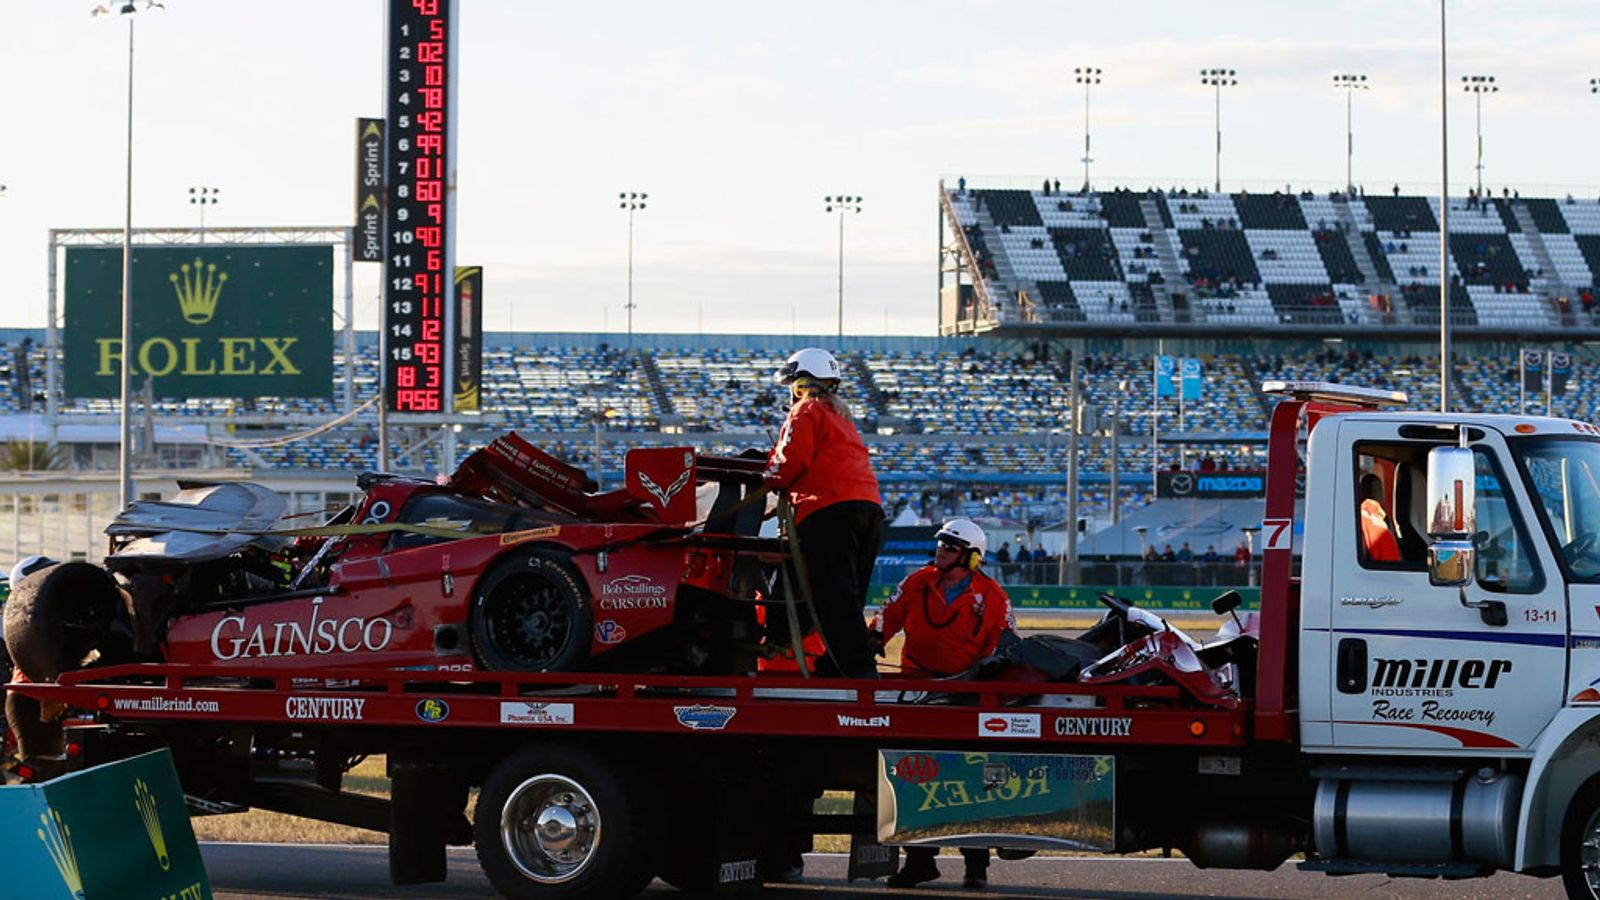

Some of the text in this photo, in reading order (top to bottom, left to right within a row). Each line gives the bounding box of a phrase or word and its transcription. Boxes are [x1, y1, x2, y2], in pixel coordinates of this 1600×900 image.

[400, 20, 444, 39] 1 5
[400, 42, 444, 62] 2 02
[399, 65, 443, 86] 3 10
[398, 88, 442, 108] 4 78
[398, 111, 442, 132] 5 42
[398, 134, 442, 155] 6 99
[365, 141, 381, 186] Sprint
[398, 158, 442, 178] 7 01
[398, 180, 442, 201] 8 60
[397, 204, 441, 224] 9 9
[364, 214, 380, 258] Sprint
[394, 226, 441, 247] 10 90
[393, 250, 441, 270] 11 6
[392, 274, 440, 294] 12 91
[392, 297, 440, 318] 13 11
[392, 320, 440, 340] 14 12
[95, 337, 301, 376] ROLEX
[392, 344, 440, 364] 15 93
[460, 343, 472, 377] Sprint
[397, 366, 440, 387] 18 3
[397, 390, 440, 411] 1956
[1197, 477, 1262, 492] mazda
[1263, 521, 1290, 547] 7
[603, 583, 666, 596] Bob Stallings
[600, 597, 667, 610] CARS.COM
[1524, 609, 1557, 622] 13-11
[211, 597, 393, 660] GAINSCO
[1372, 658, 1512, 689] miller
[1372, 689, 1453, 697] INDUSTRIES
[114, 698, 219, 712] www.millerind.com
[285, 697, 366, 721] CENTURY
[1372, 700, 1496, 727] Race Recovery
[508, 714, 535, 722] Phoenix
[538, 714, 553, 723] USA
[1055, 717, 1132, 736] CENTURY
[1009, 757, 1094, 768] NOT FOR HIRE
